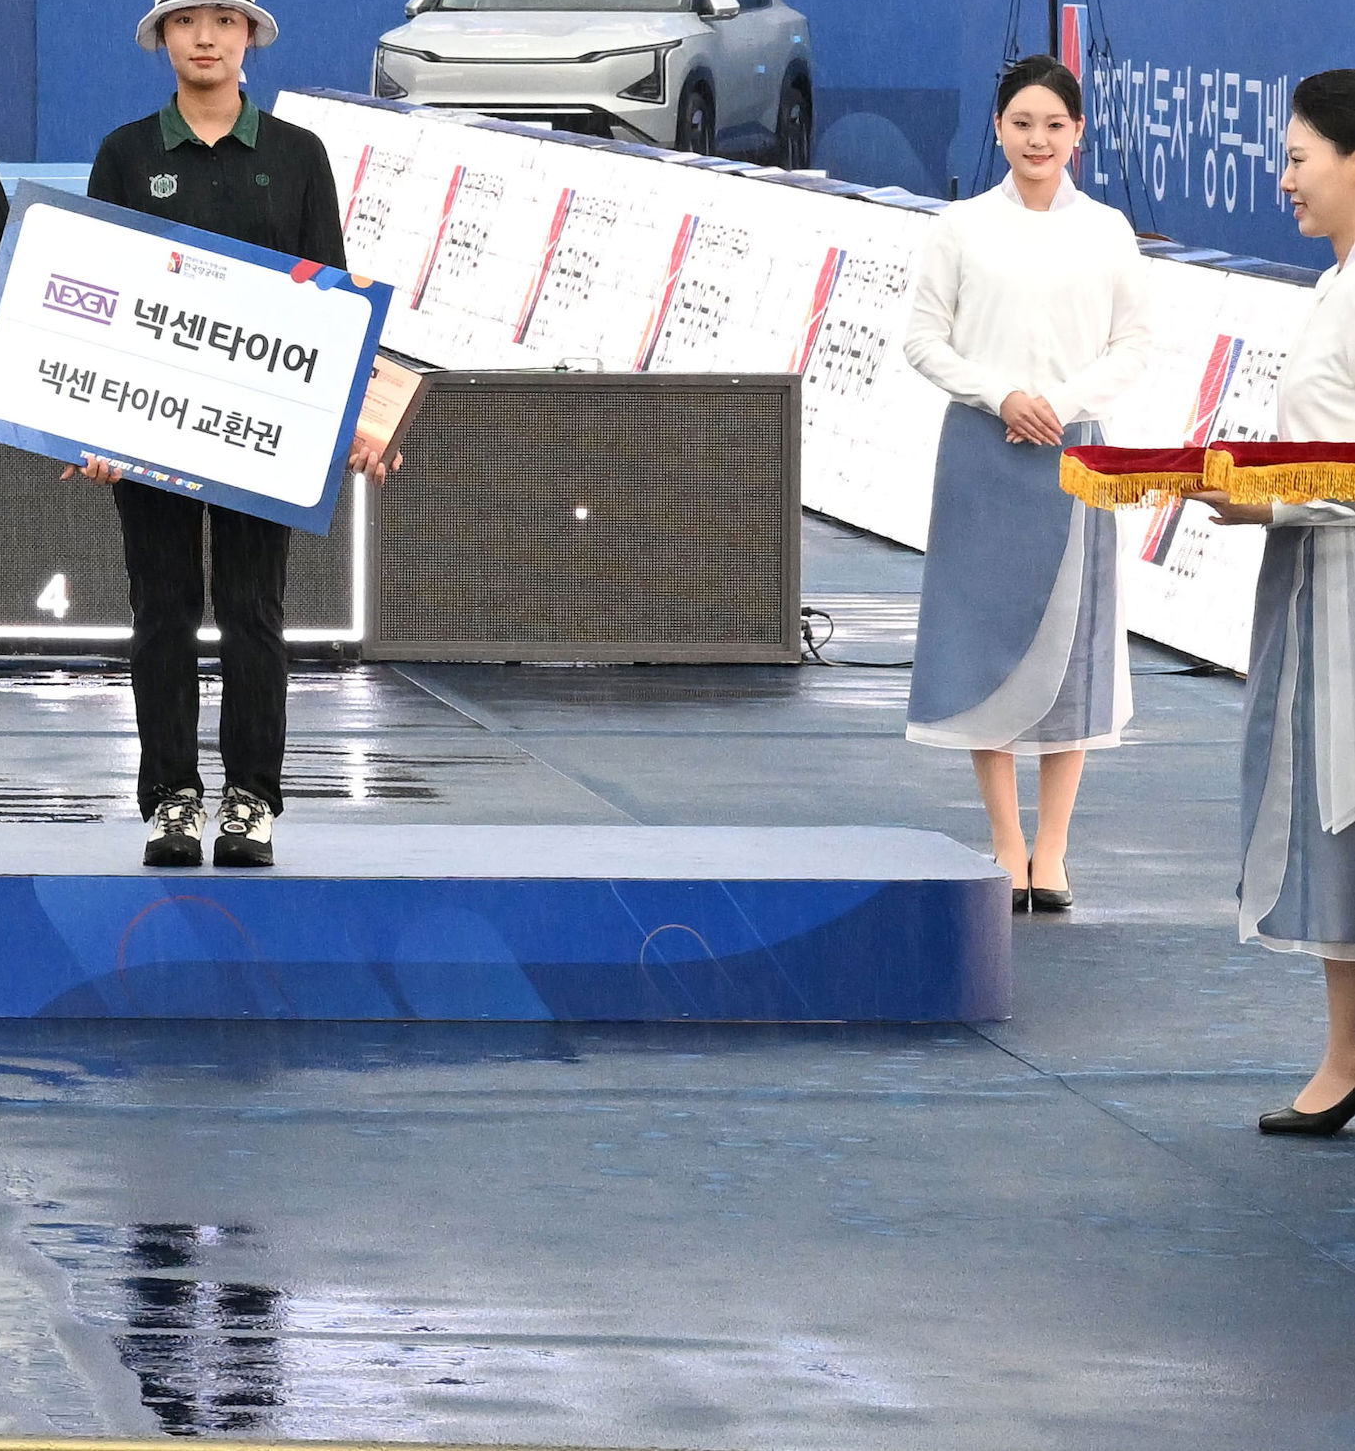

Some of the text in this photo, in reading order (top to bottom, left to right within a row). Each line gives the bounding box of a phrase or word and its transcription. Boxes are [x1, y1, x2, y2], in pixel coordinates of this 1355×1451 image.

[1093, 53, 1288, 213] 현대자동차 정몽구배
[44, 280, 118, 318] NEXEN
[134, 298, 319, 383] 넥센타이어
[39, 359, 283, 457] 넥센 타이어 교환권
[36, 573, 70, 619] 4
